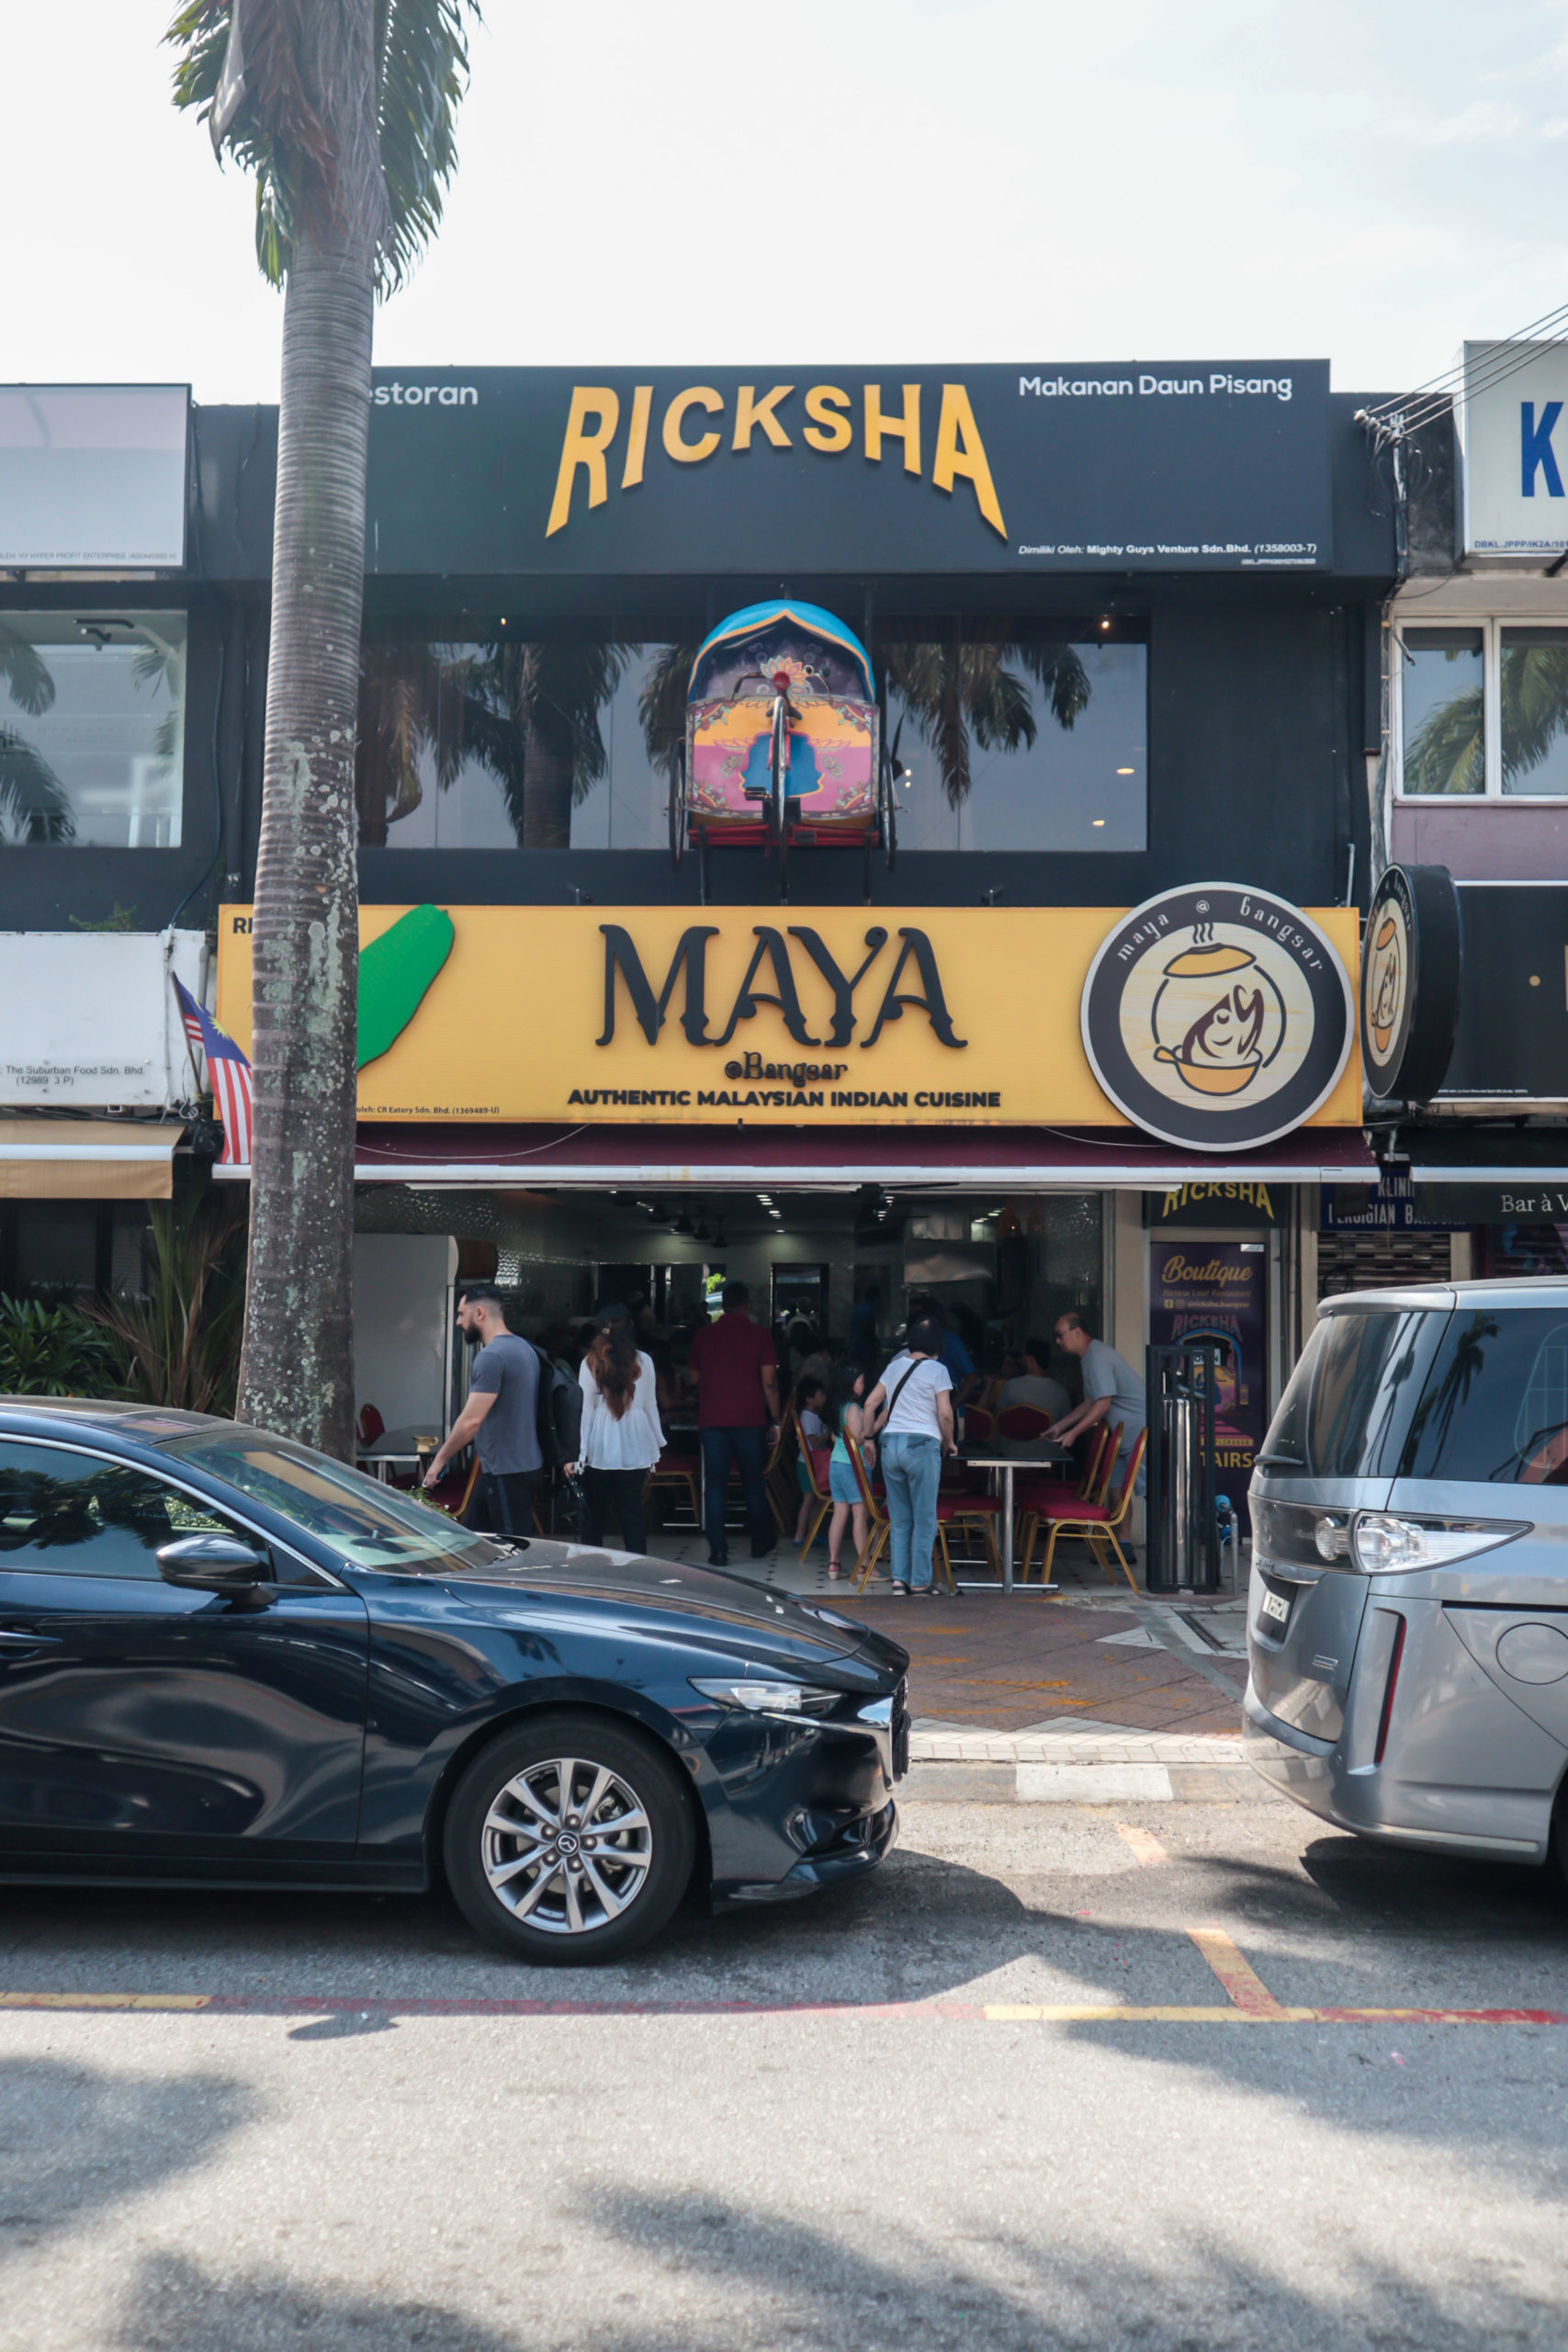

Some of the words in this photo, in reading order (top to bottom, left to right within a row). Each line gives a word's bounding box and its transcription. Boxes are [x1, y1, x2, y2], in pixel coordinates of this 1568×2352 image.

[1019, 376, 1134, 396] Makanan
[1138, 375, 1204, 395] Daun
[1209, 374, 1292, 401] Pisang
[545, 383, 1009, 541] RICKSHA
[1520, 401, 1566, 497] K
[1018, 545, 1055, 555] Dimiliki
[1087, 544, 1123, 556] Mighty
[1126, 544, 1156, 556] Guys
[1156, 544, 1199, 554] Venture
[1117, 912, 1169, 961] maya
[1196, 899, 1211, 914] @
[1239, 895, 1324, 971] bangsar
[594, 923, 969, 1049] MAYA
[6, 1065, 24, 1075] The
[26, 1065, 71, 1075] Suburban
[73, 1065, 97, 1075] Food
[100, 1065, 121, 1075] Sdn.
[124, 1065, 145, 1075] Bhd.
[389, 1106, 413, 1114] Eatery
[415, 1106, 431, 1114] Sdn.
[433, 1106, 451, 1114] Bhd.
[568, 1089, 692, 1107] AUTHENTIC
[697, 1090, 825, 1108] MALAYSIAN
[830, 1091, 908, 1108] INDIAN
[914, 1091, 1001, 1108] CUISINE
[1162, 1182, 1275, 1221] RICKSHA
[1501, 1194, 1536, 1213] Bar
[1540, 1193, 1553, 1213] à
[1161, 1255, 1253, 1288] Boutique
